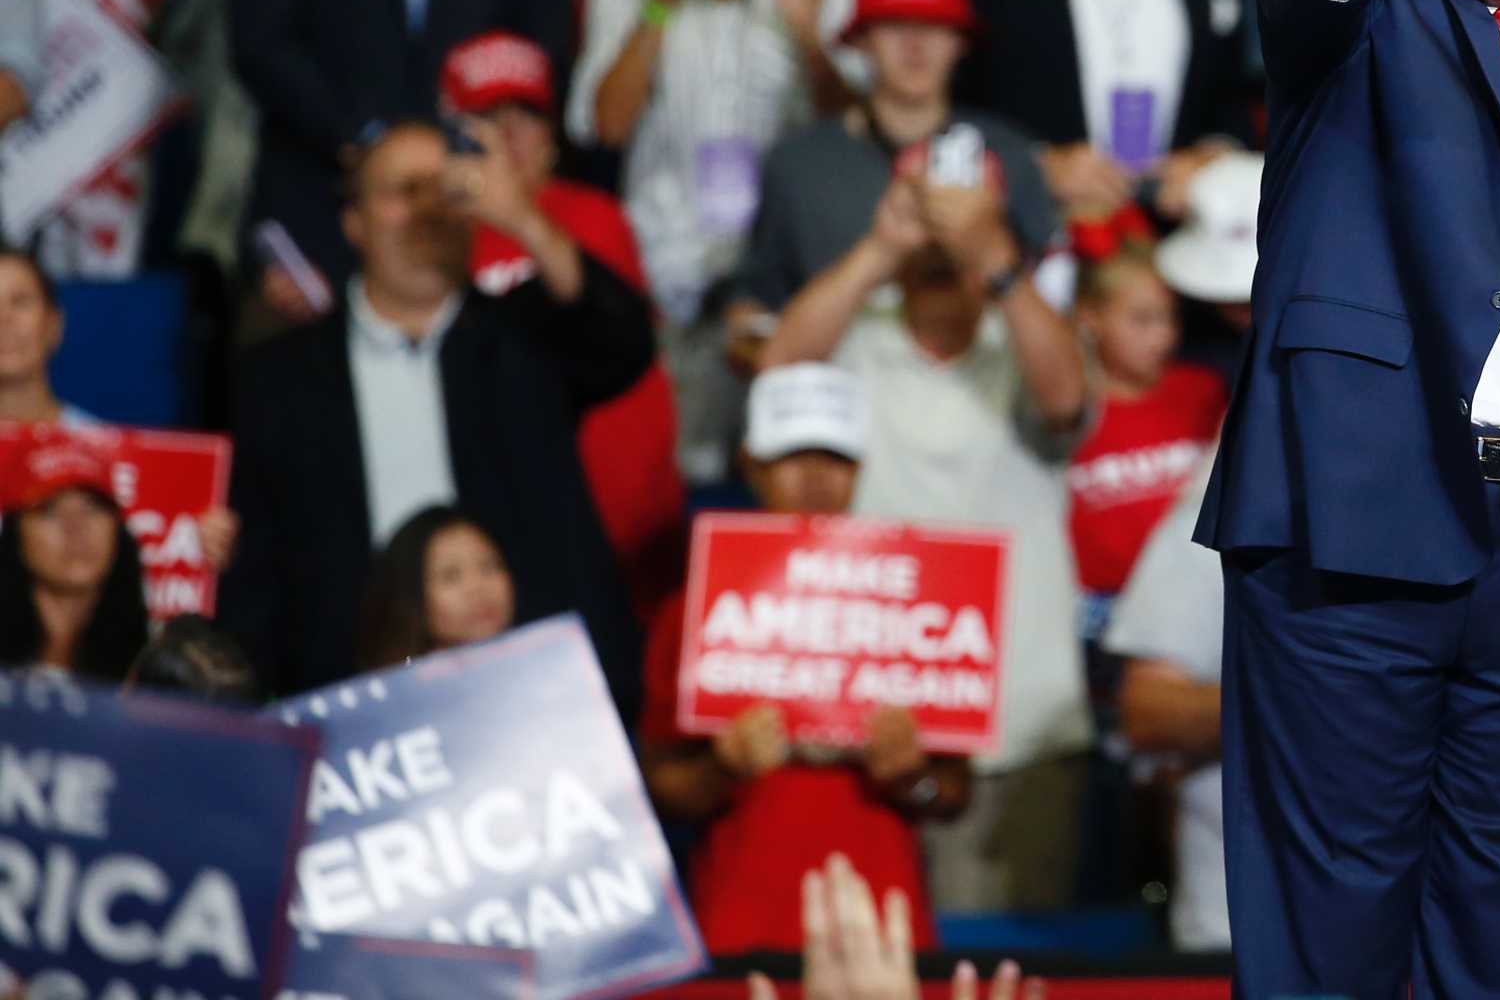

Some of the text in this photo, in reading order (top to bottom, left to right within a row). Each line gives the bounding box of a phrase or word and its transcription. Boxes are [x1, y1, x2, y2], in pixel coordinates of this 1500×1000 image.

[786, 547, 920, 601] MAKE
[702, 590, 994, 663] AMERICA
[697, 649, 992, 712] GREAT AGAIN
[0, 743, 116, 838] KE
[306, 724, 454, 822] AKE
[292, 767, 622, 935] ERICA
[0, 842, 257, 979] RICA
